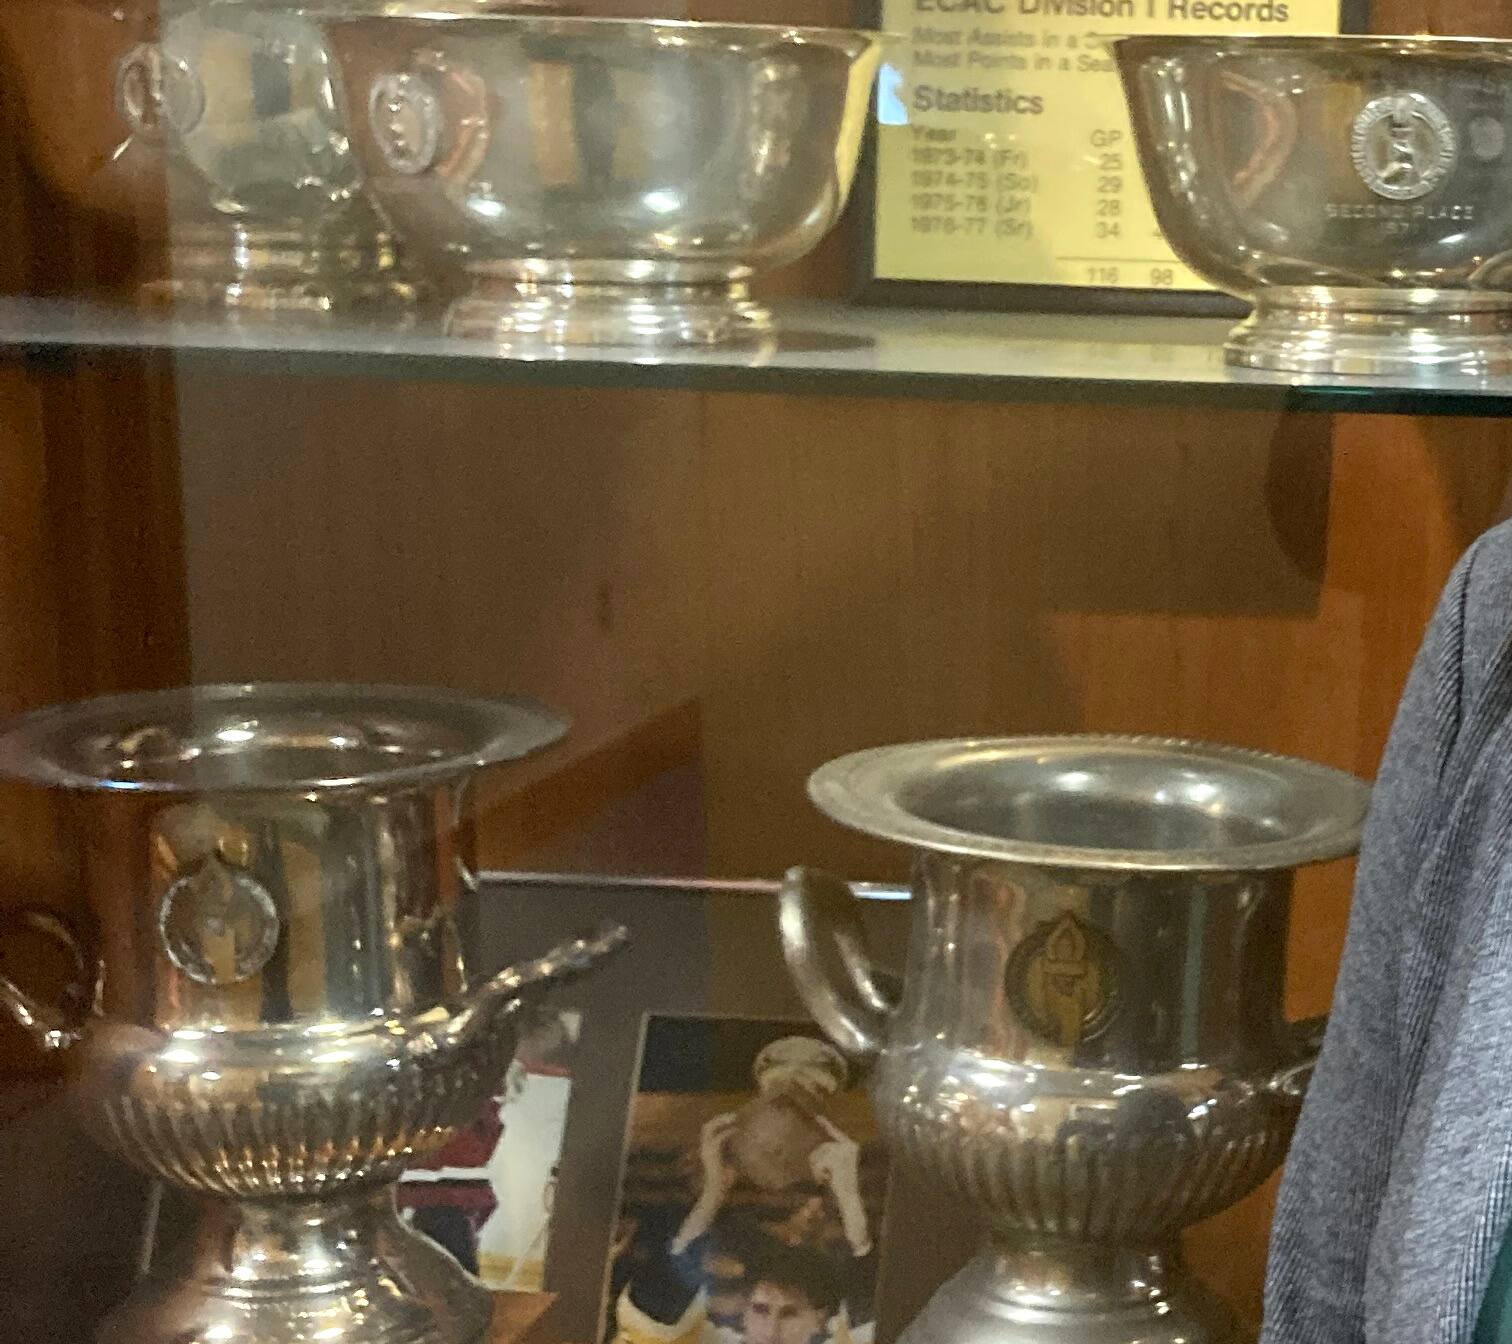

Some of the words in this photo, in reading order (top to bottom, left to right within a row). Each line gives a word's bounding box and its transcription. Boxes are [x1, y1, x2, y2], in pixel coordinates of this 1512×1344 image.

[913, 85, 1044, 115] Statistics
[1091, 130, 1121, 148] GP
[1150, 268, 1174, 286] 98
